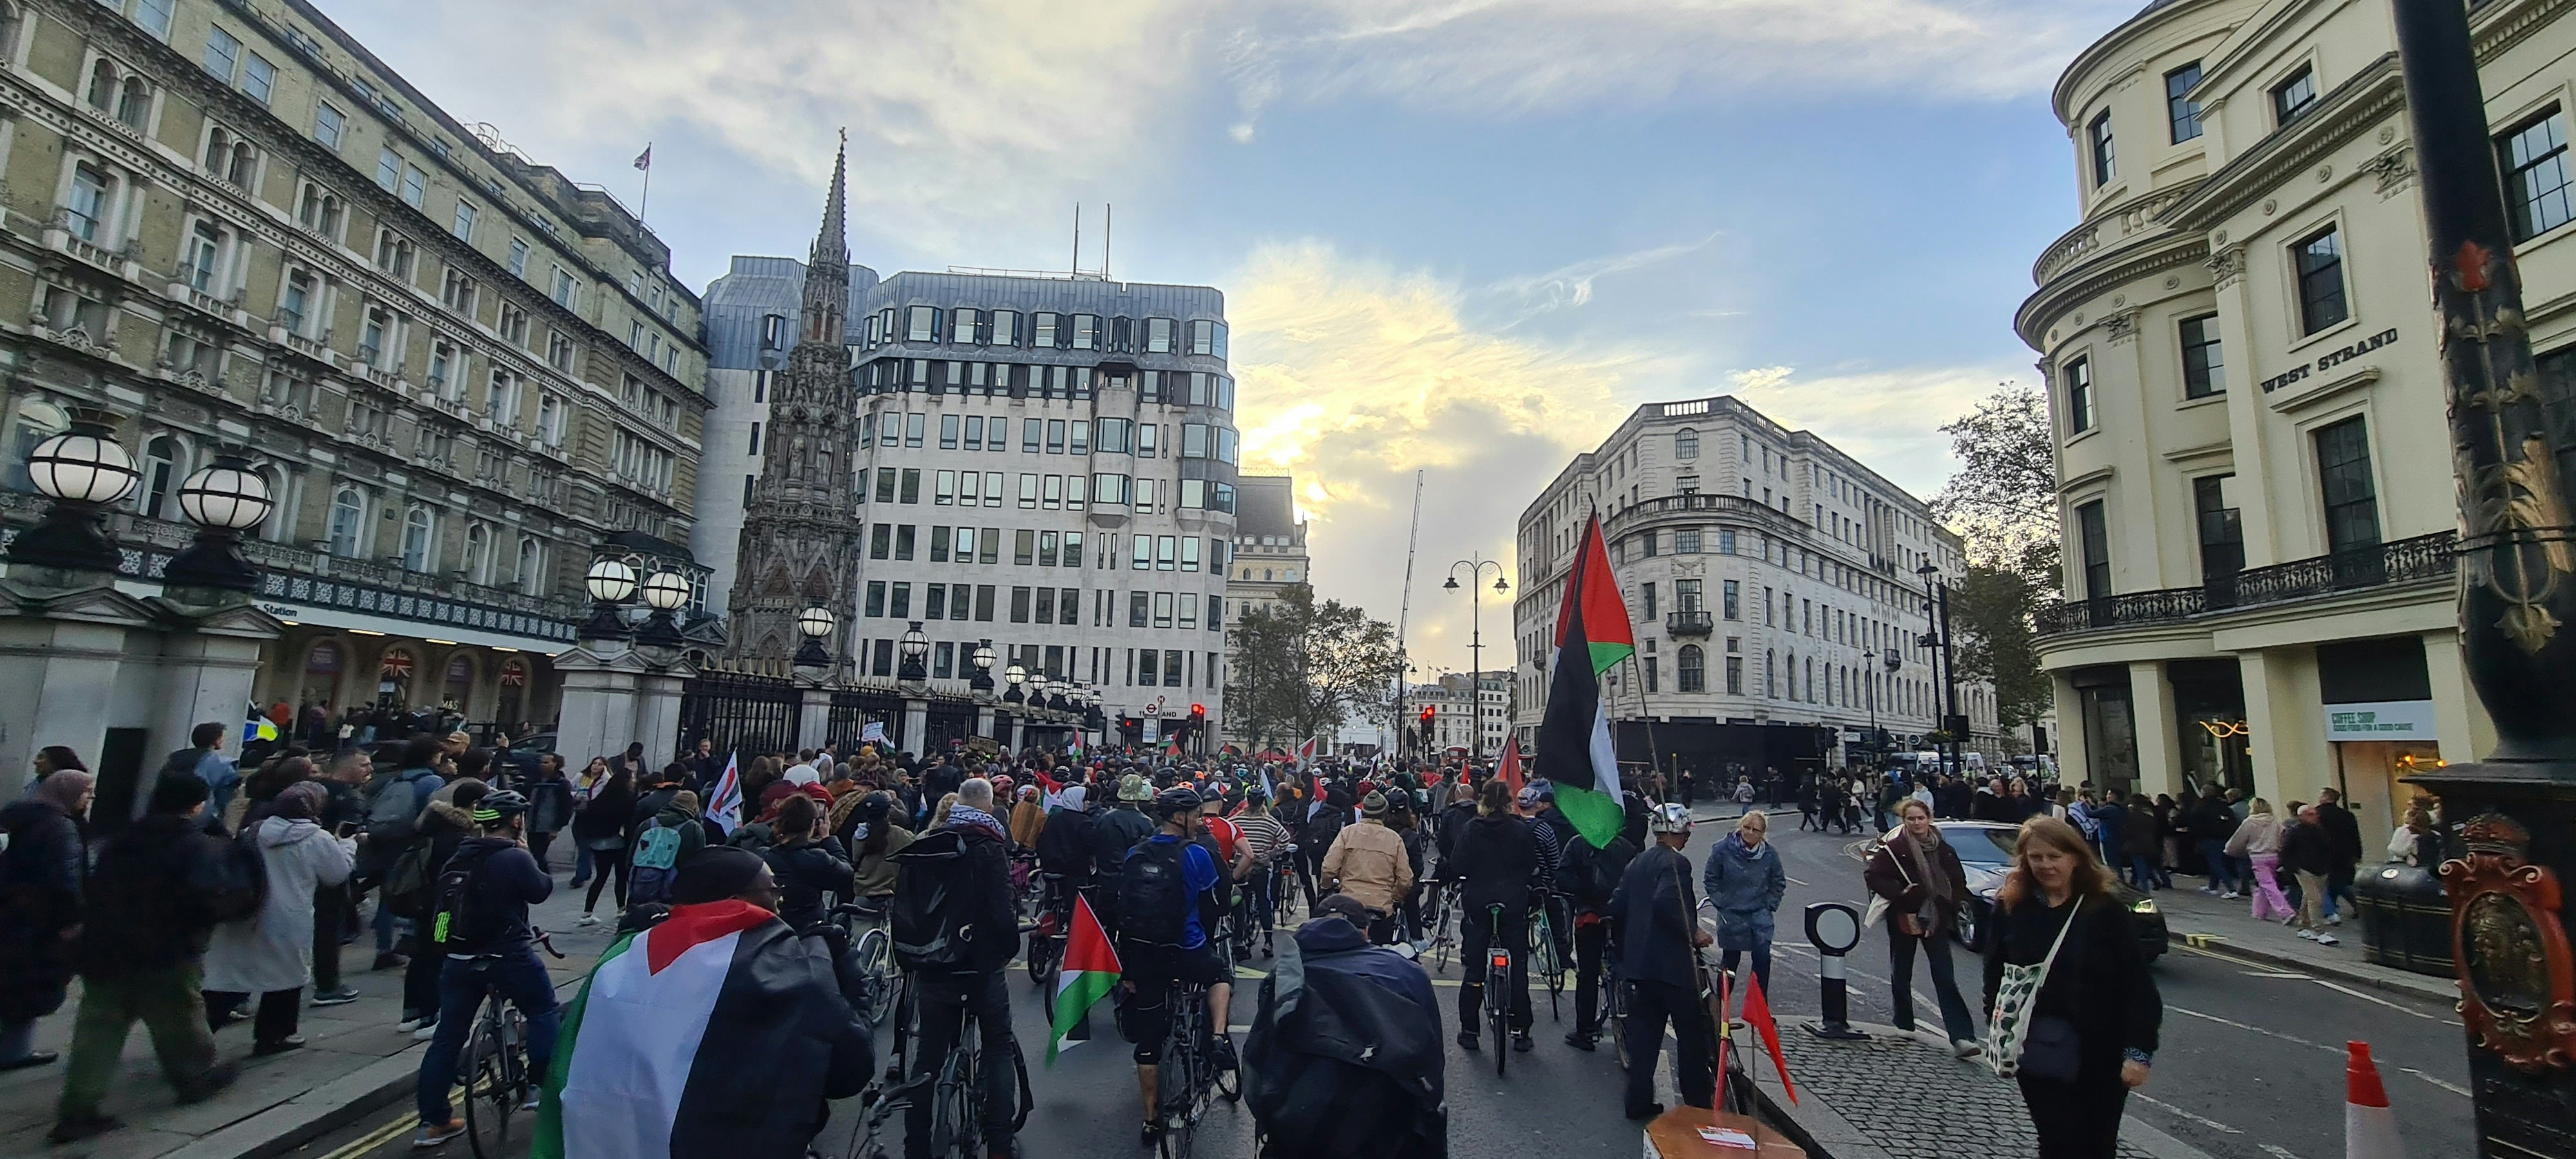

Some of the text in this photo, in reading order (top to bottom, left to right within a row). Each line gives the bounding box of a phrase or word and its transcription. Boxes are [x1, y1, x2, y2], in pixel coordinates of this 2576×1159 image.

[2260, 328, 2398, 394] WEST STRAND
[263, 604, 298, 617] Station
[441, 700, 459, 710] M&S
[2331, 711, 2375, 724] COFFEE SHOP
